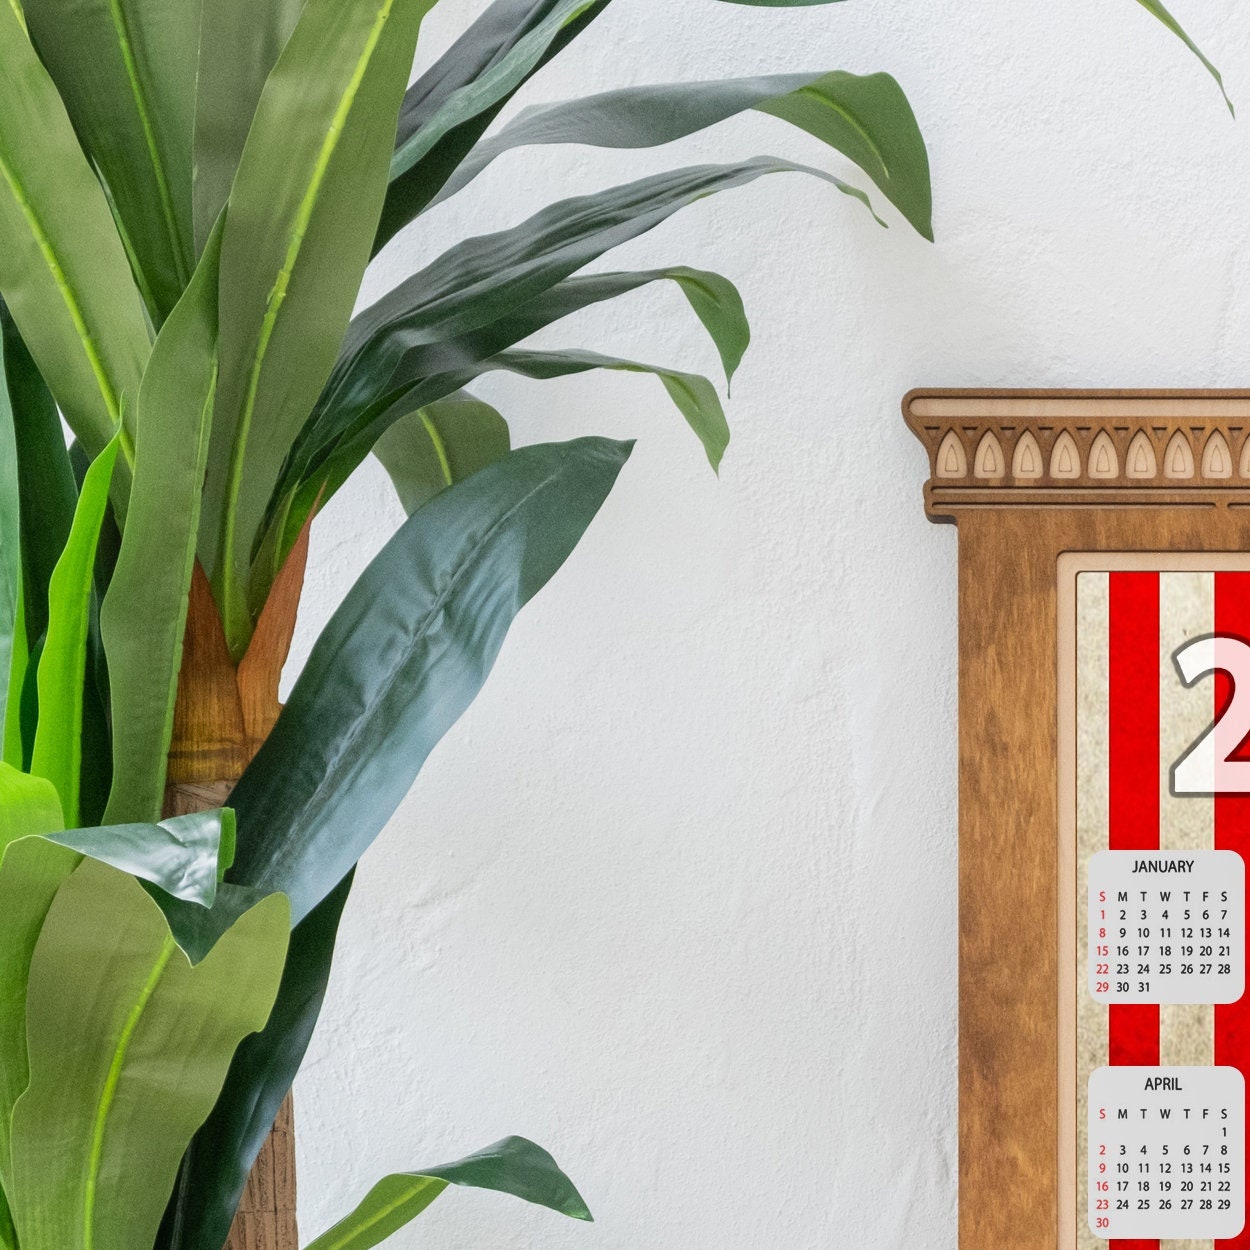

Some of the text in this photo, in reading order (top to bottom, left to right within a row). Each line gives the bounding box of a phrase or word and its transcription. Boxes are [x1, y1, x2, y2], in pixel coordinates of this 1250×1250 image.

[1131, 859, 1195, 874] JANUARY
[1099, 890, 1228, 903] S M T W T F S
[1096, 945, 1230, 957] 15 16 17 18 19 20 21
[1095, 981, 1150, 993] 29 30 31
[1143, 1076, 1183, 1091] APRIL
[1096, 1180, 1231, 1192] 16 17 18 19 20 21 22
[1096, 1217, 1110, 1228] 30
